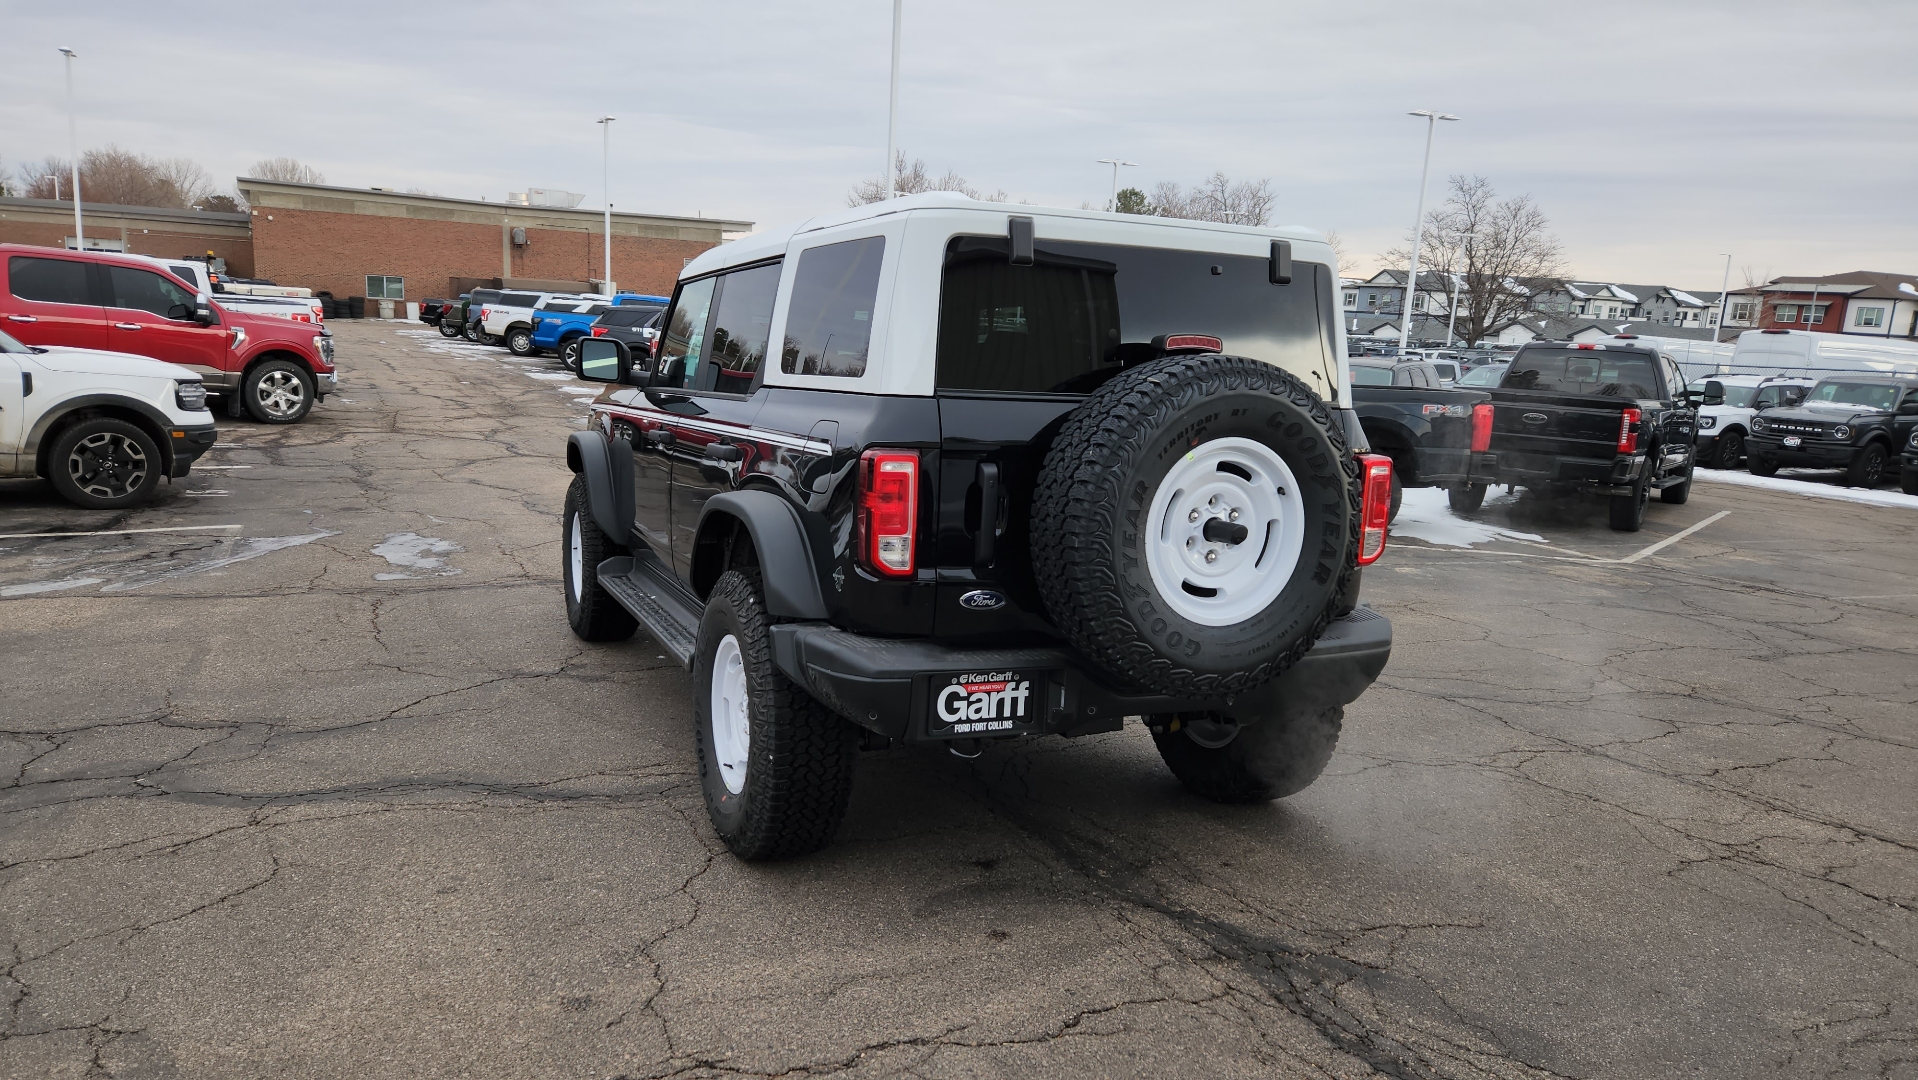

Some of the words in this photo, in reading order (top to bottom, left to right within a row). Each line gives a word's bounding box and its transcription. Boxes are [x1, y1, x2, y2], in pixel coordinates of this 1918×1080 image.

[1422, 404, 1464, 417] FX4
[1157, 411, 1221, 460] TERRITORY
[1231, 408, 1249, 417] RT
[971, 594, 996, 606] Ford
[968, 673, 988, 683] Ken
[989, 671, 1013, 682] Garff
[937, 681, 1030, 723] Garff
[954, 723, 971, 733] FORD
[971, 721, 987, 731] FORT
[988, 720, 1013, 731] COLLINS
